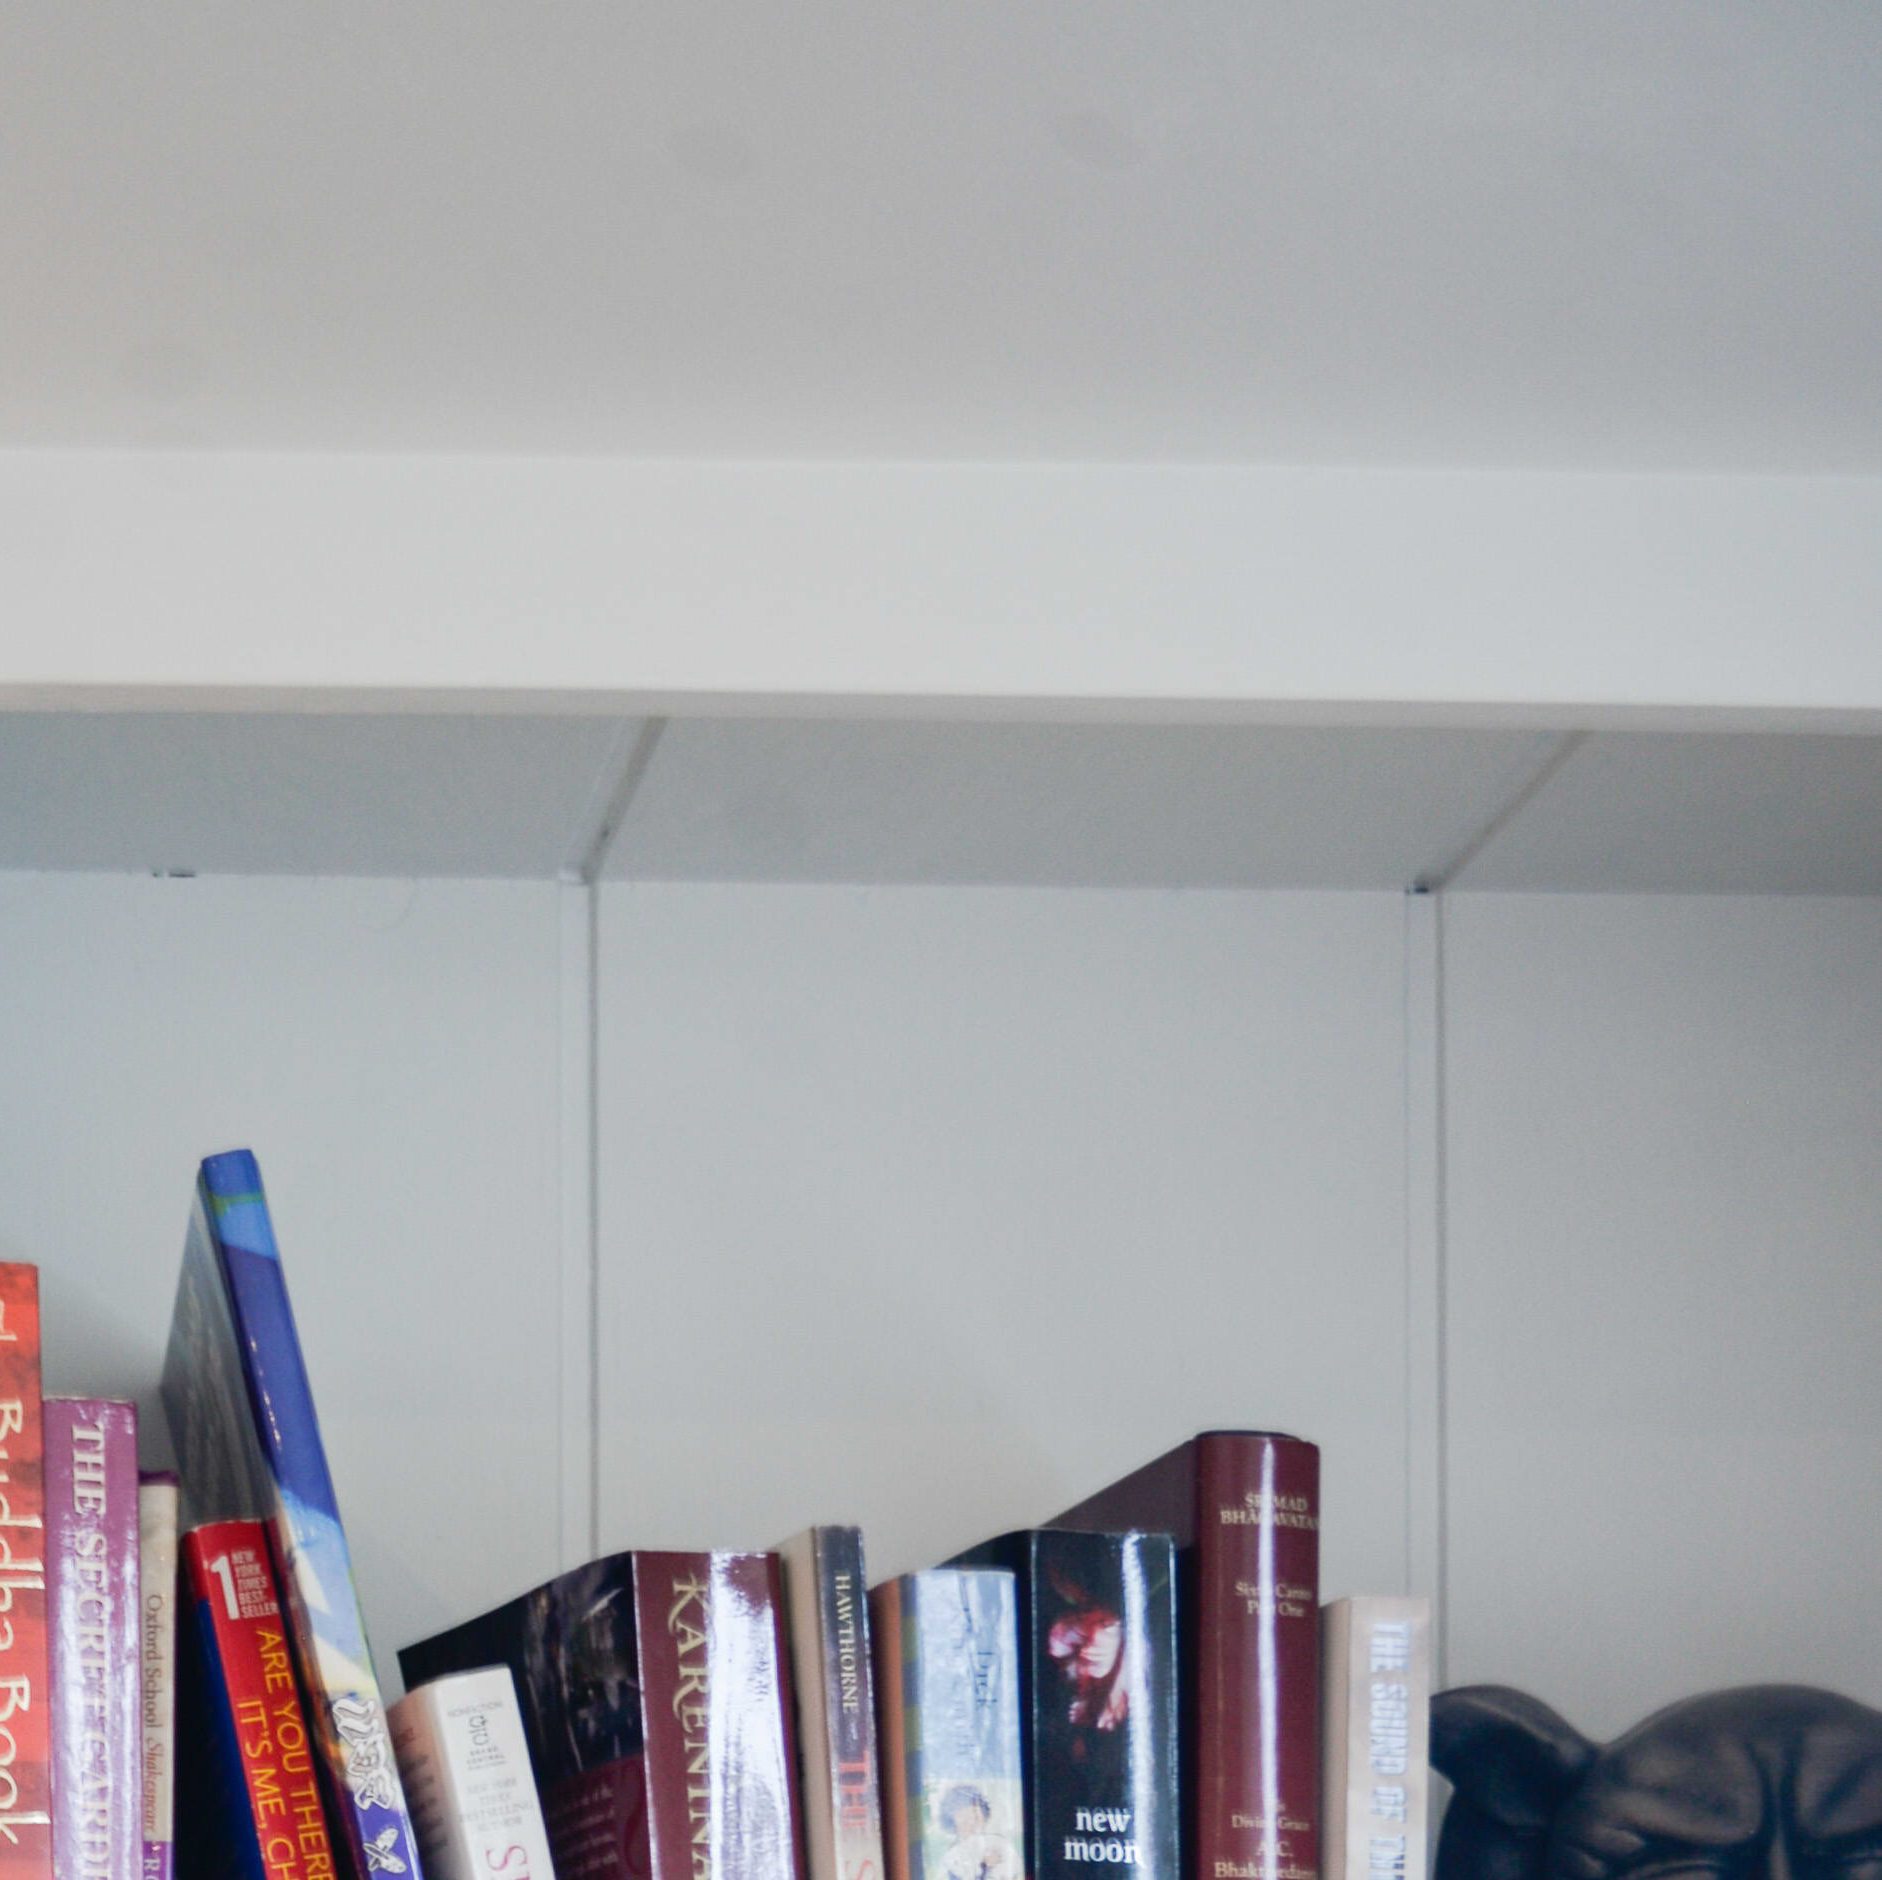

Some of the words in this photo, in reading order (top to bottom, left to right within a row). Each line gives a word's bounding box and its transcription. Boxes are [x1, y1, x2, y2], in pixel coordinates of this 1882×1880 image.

[70, 1421, 107, 1517] THE
[145, 1595, 165, 1661] Oxford
[834, 1574, 860, 1714] HAWTHORNE
[145, 1668, 165, 1728] School
[257, 1631, 289, 1694] ARE
[273, 1701, 310, 1773] YOU
[1075, 1806, 1132, 1833] new
